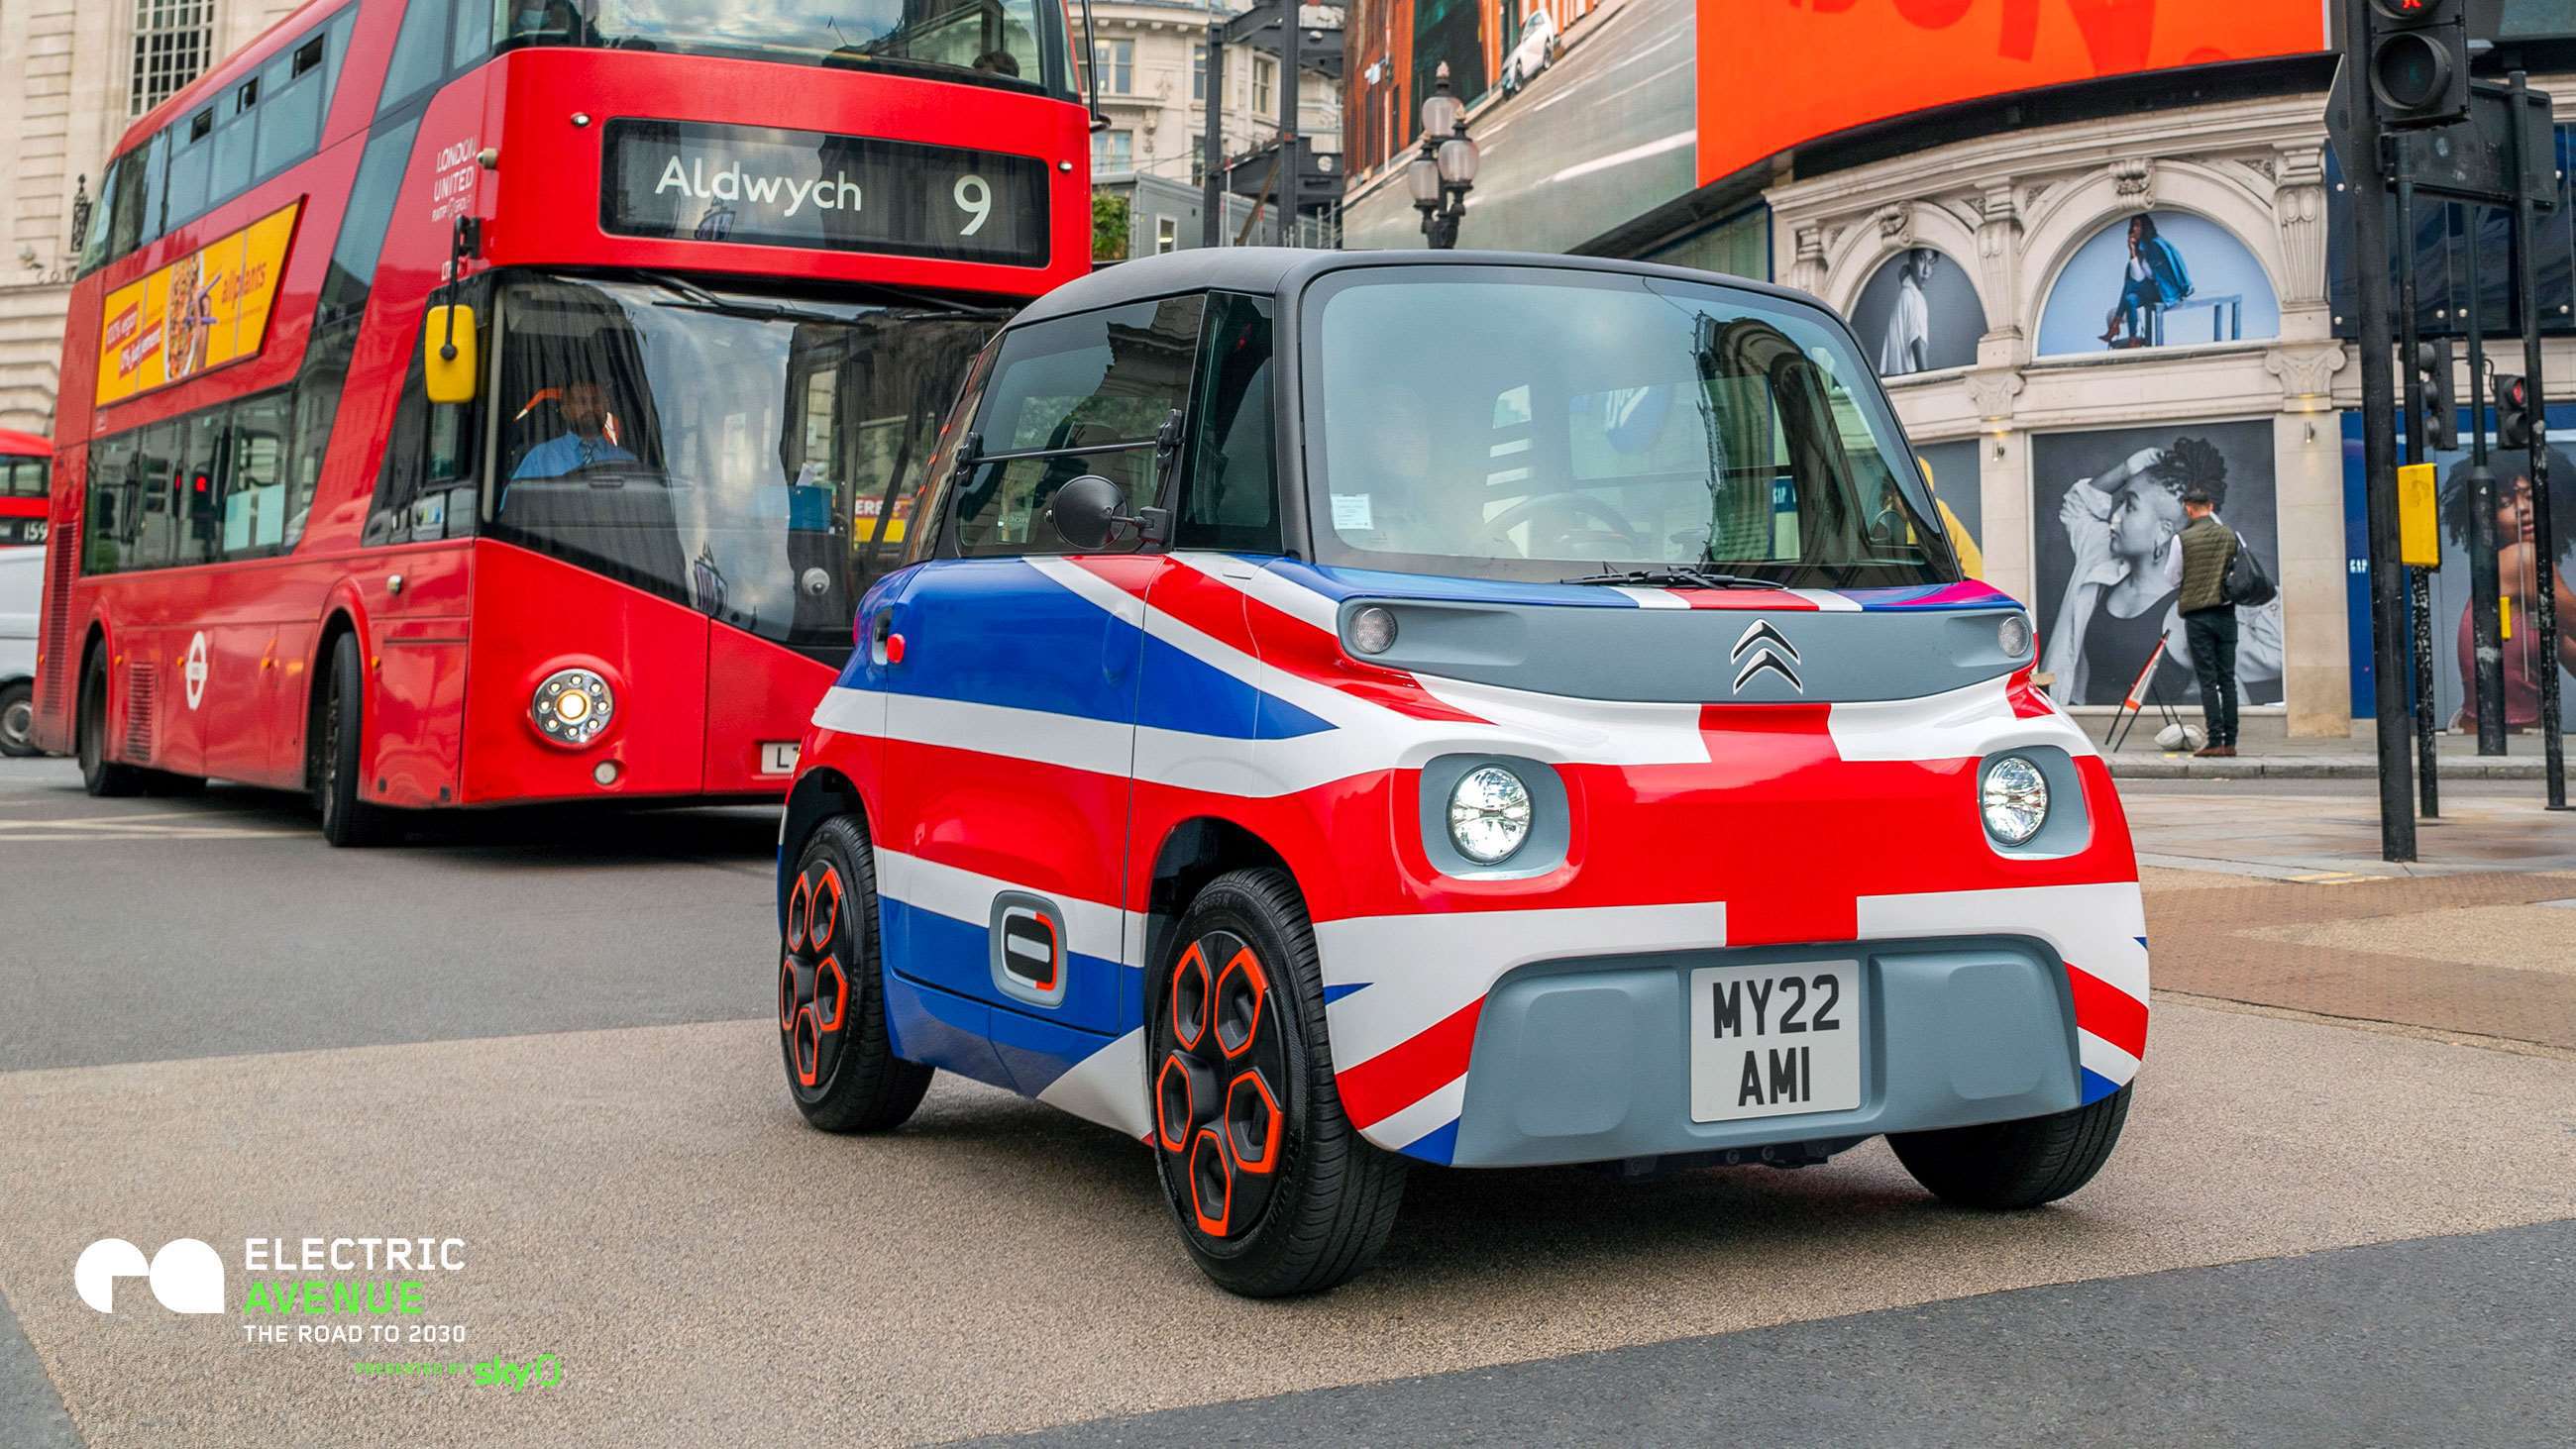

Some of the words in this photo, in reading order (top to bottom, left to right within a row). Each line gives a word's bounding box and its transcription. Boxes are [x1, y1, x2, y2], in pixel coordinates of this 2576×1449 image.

[433, 164, 475, 202] UNITED
[436, 137, 478, 173] LONDON
[654, 155, 862, 217] Aldwych
[952, 174, 992, 236] 9
[776, 746, 799, 769] L
[1712, 974, 1840, 1039] MY22
[1738, 1046, 1811, 1107] AMI
